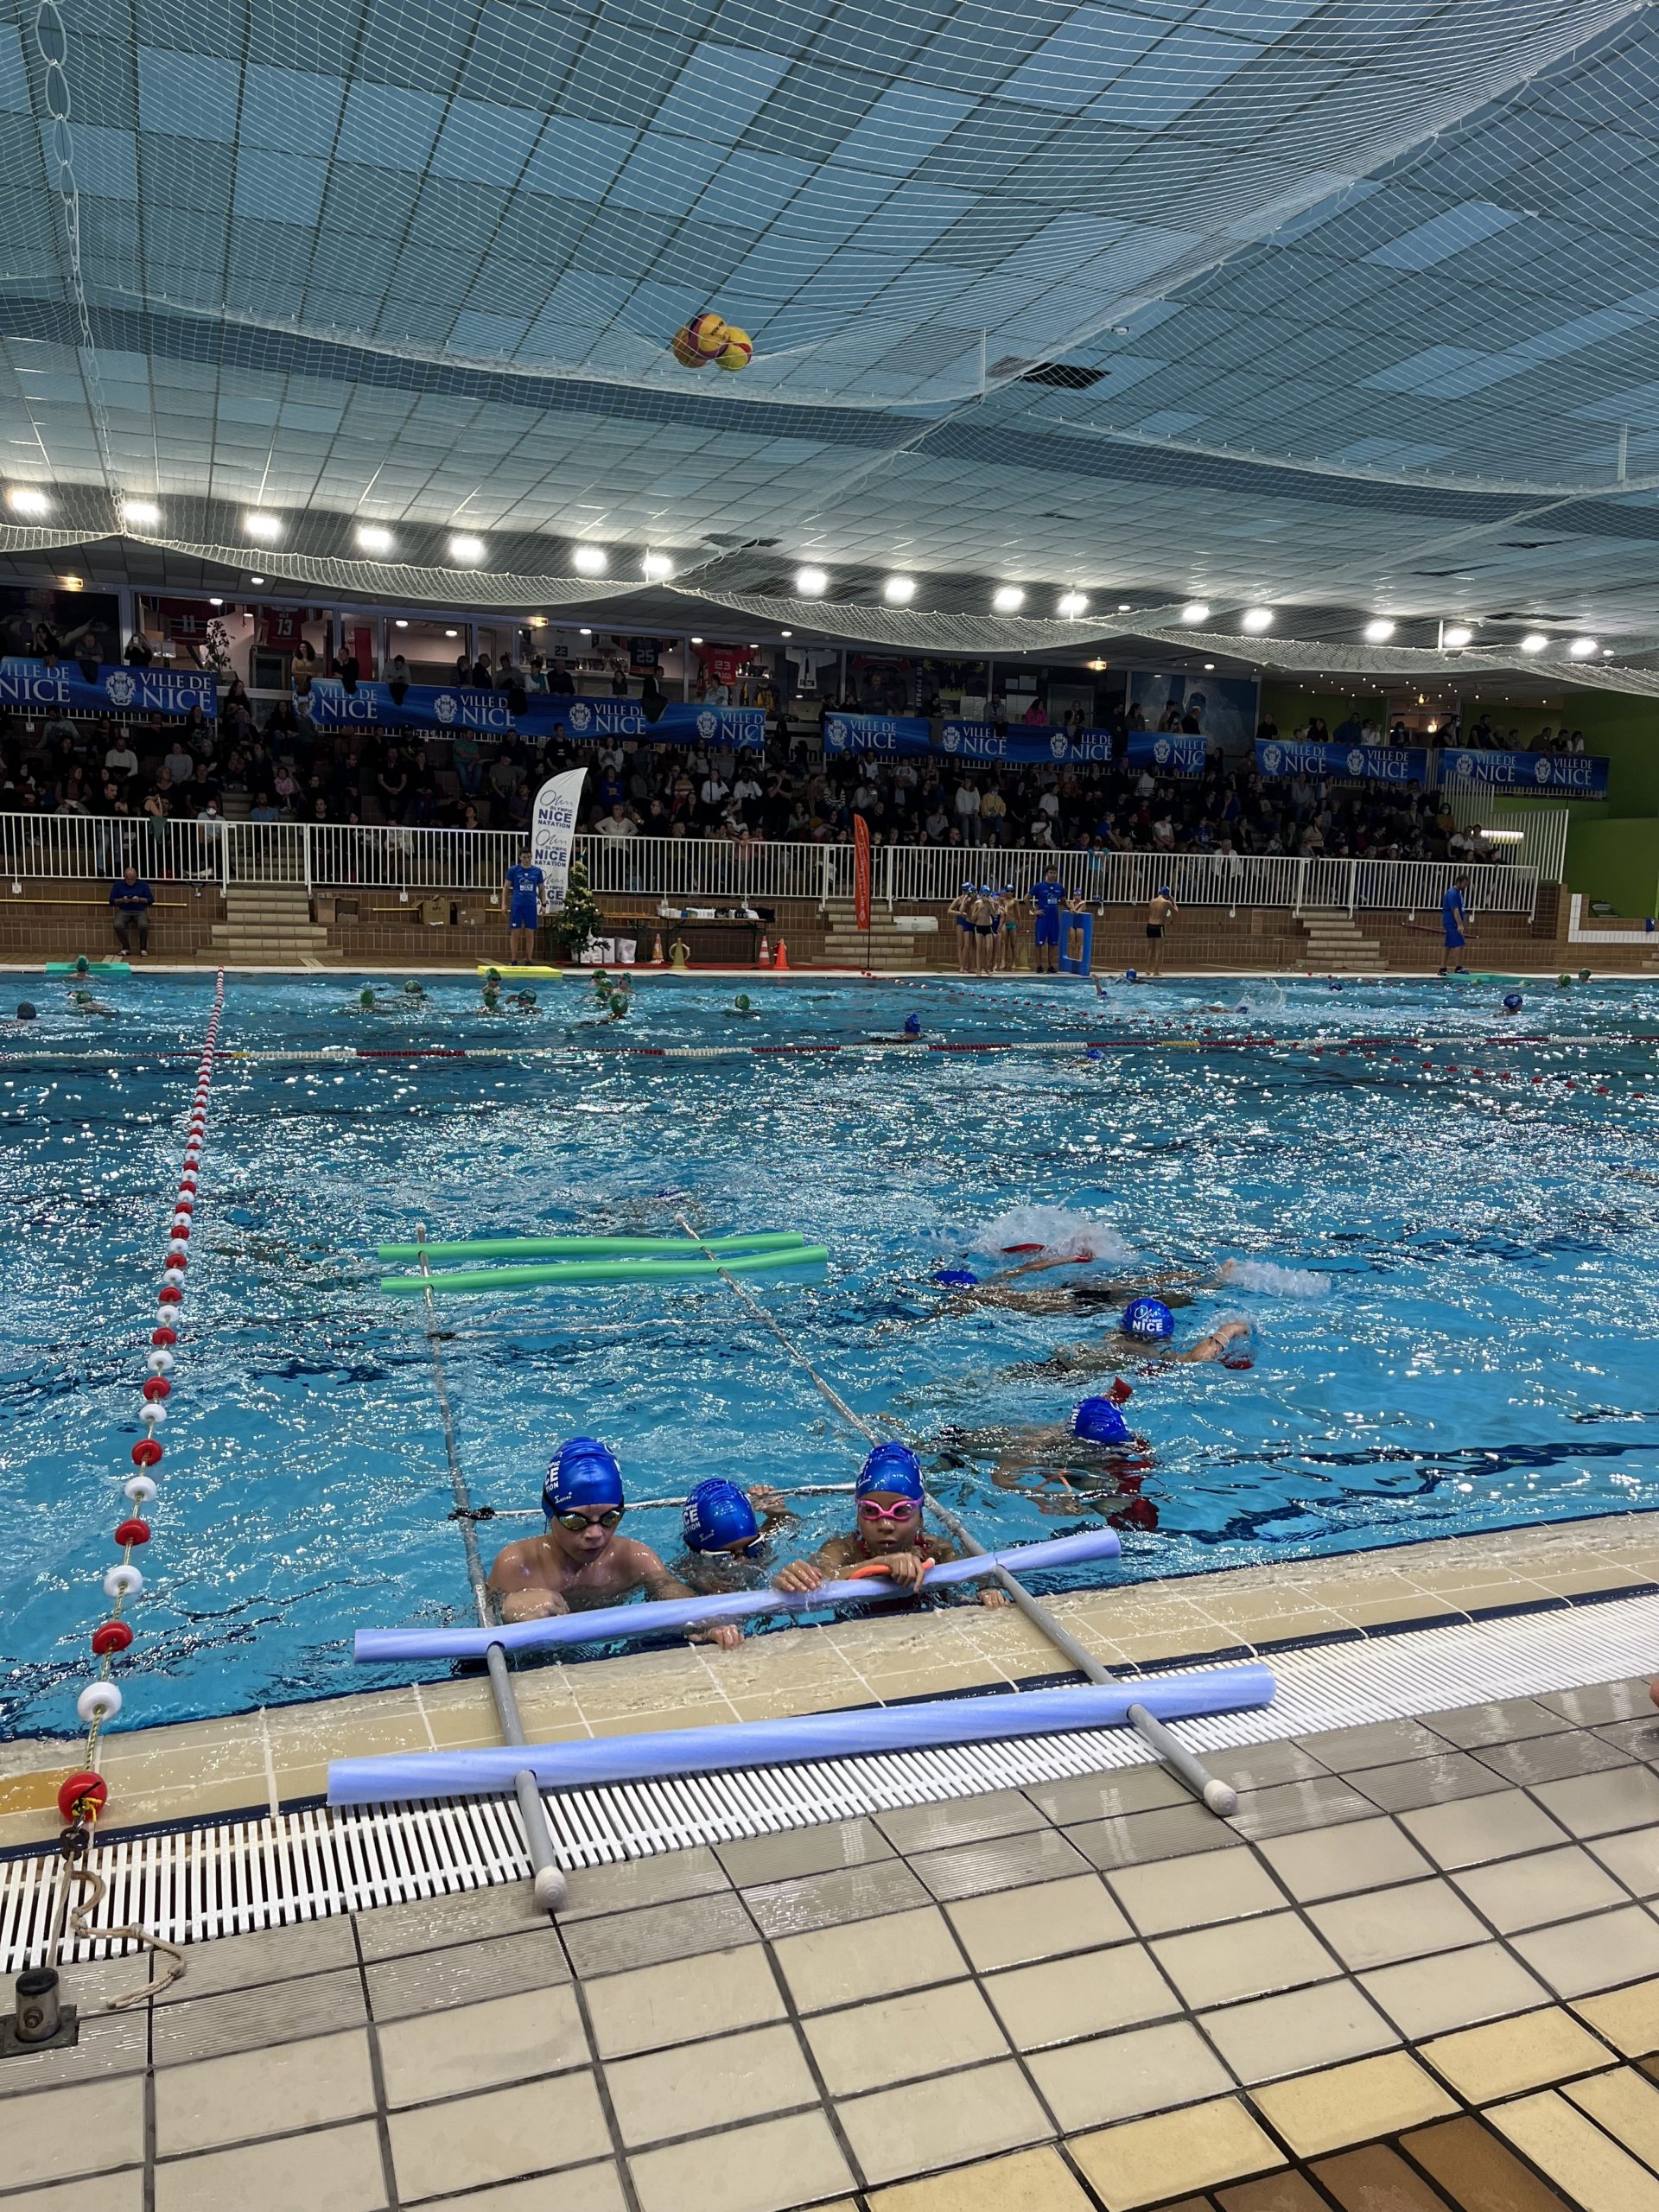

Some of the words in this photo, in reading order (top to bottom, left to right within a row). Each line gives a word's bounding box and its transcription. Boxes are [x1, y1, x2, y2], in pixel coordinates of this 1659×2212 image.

[276, 618, 293, 636] 13
[555, 645, 568, 657] 23
[636, 648, 656, 664] 25
[715, 660, 731, 670] 23
[52, 667, 69, 680] DE
[139, 672, 185, 688] VILLE
[190, 677, 211, 690] DE
[0, 677, 70, 702] NICE
[359, 689, 378, 701] DE
[141, 687, 212, 711] NICE
[461, 695, 495, 708] VILLE
[499, 697, 508, 709] D
[321, 699, 378, 719] NICE
[594, 703, 627, 716] VILLE
[461, 707, 516, 727] NICE
[721, 711, 751, 723] VILLE
[594, 715, 646, 734] NICE
[849, 720, 879, 732] VILLE
[882, 722, 897, 733] DE
[963, 726, 991, 738] VILLE
[851, 731, 897, 749] NICE
[963, 737, 1007, 755] NICE
[1081, 734, 1098, 744] LLE
[1100, 734, 1113, 745] DE
[1173, 740, 1198, 750] VILLE
[1071, 743, 1112, 760] NICE
[1173, 749, 1205, 766] NIC
[1283, 745, 1311, 756] VILLE
[1313, 747, 1327, 757] DE
[1367, 749, 1394, 760] VILLE
[1395, 750, 1409, 762] DE
[1284, 755, 1326, 774] NICE
[1475, 754, 1503, 766] VILLE
[1505, 755, 1517, 766] DE
[1553, 758, 1580, 769] VILLE
[1581, 759, 1592, 770] DE
[1367, 760, 1408, 779] NICE
[1476, 765, 1516, 782] NICE
[1553, 768, 1592, 785] NICE
[538, 808, 572, 823] NICE
[537, 819, 571, 829] NATATION
[535, 849, 567, 861] NICE
[547, 890, 563, 899] CE
[1132, 1320, 1163, 1332] NICE
[544, 1466, 559, 1486] CE
[545, 1481, 559, 1493] TION
[683, 1508, 699, 1526] CE
